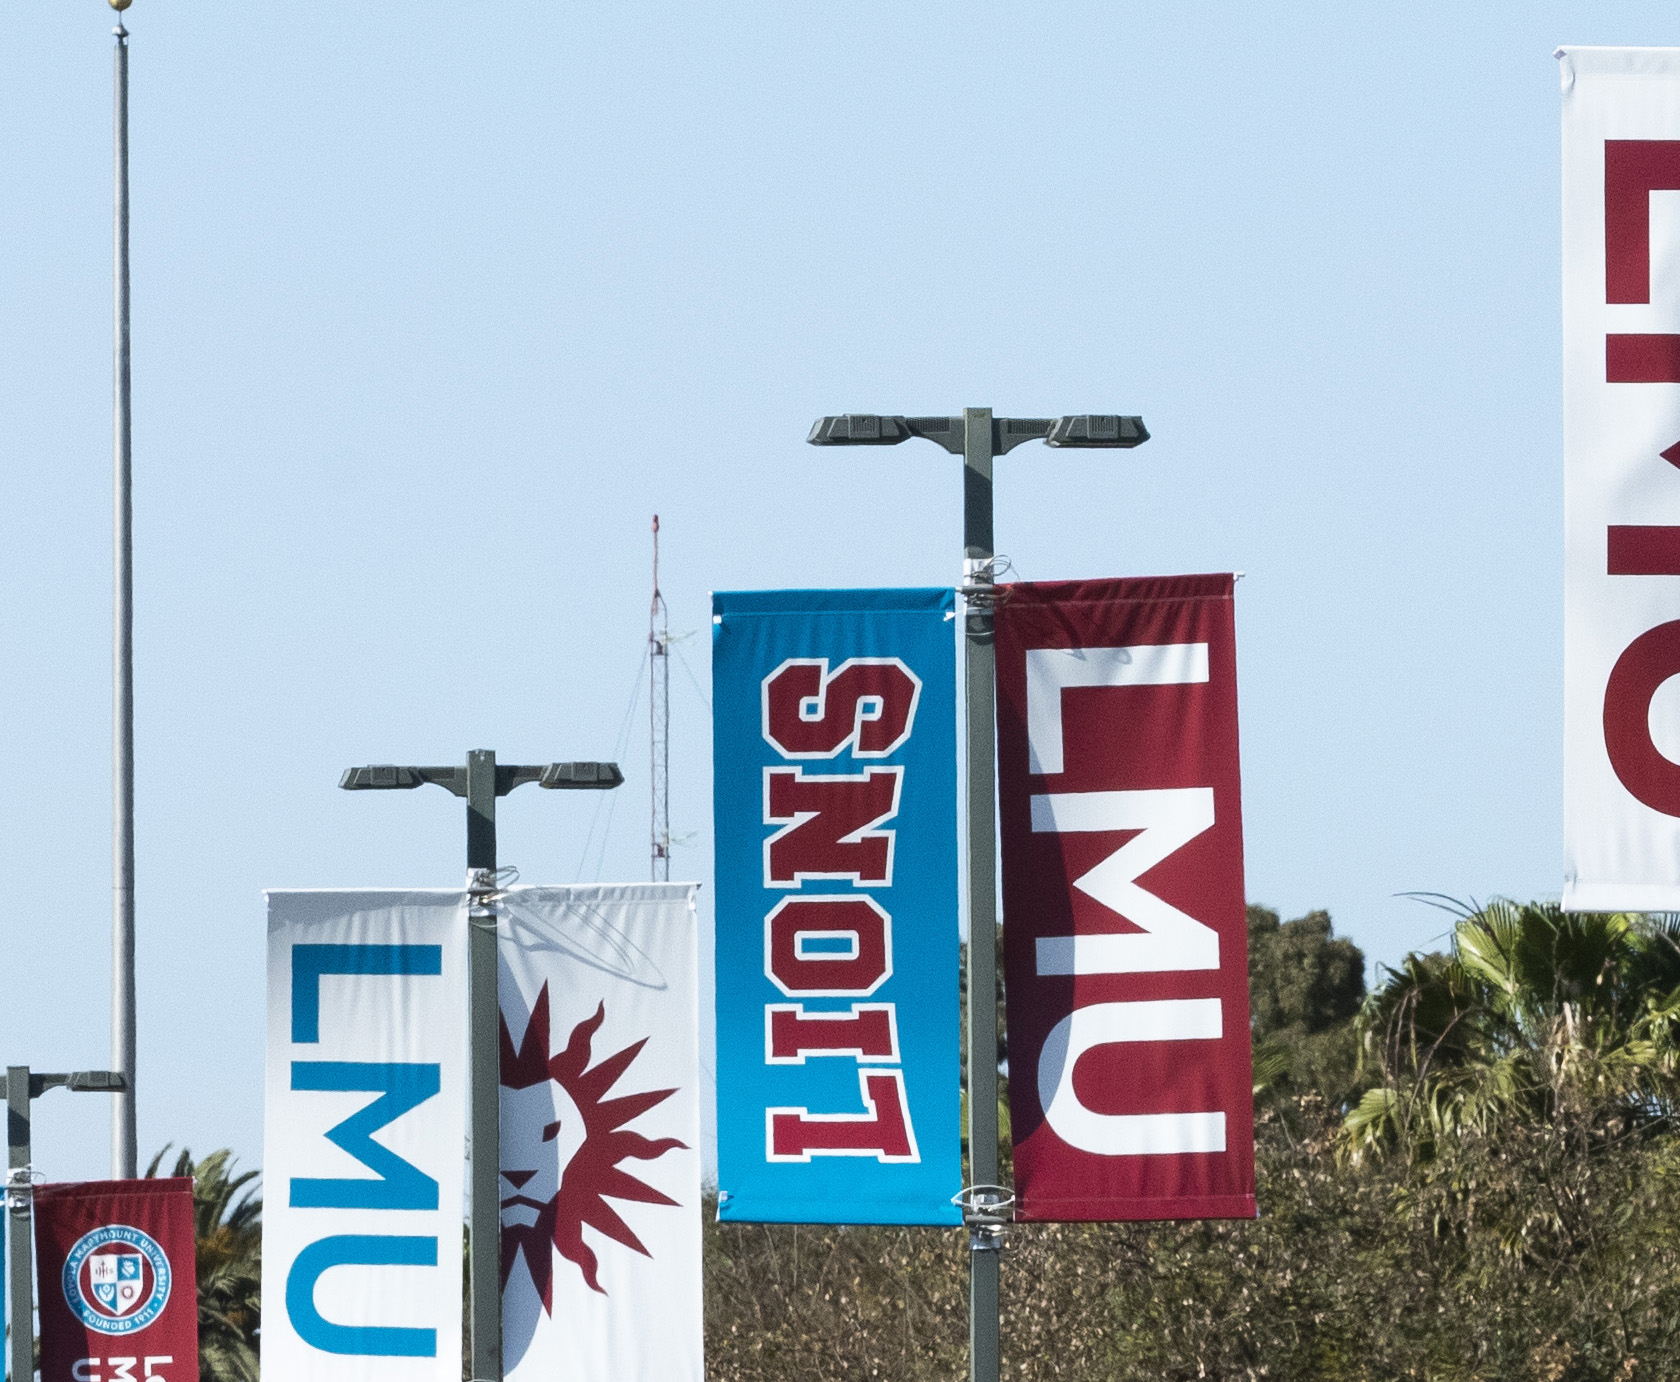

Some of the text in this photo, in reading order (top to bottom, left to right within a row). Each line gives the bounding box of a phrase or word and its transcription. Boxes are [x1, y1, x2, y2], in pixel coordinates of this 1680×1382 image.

[284, 943, 442, 1358] LMU
[760, 656, 924, 1164] LIONS
[1025, 642, 1228, 1156] LMU
